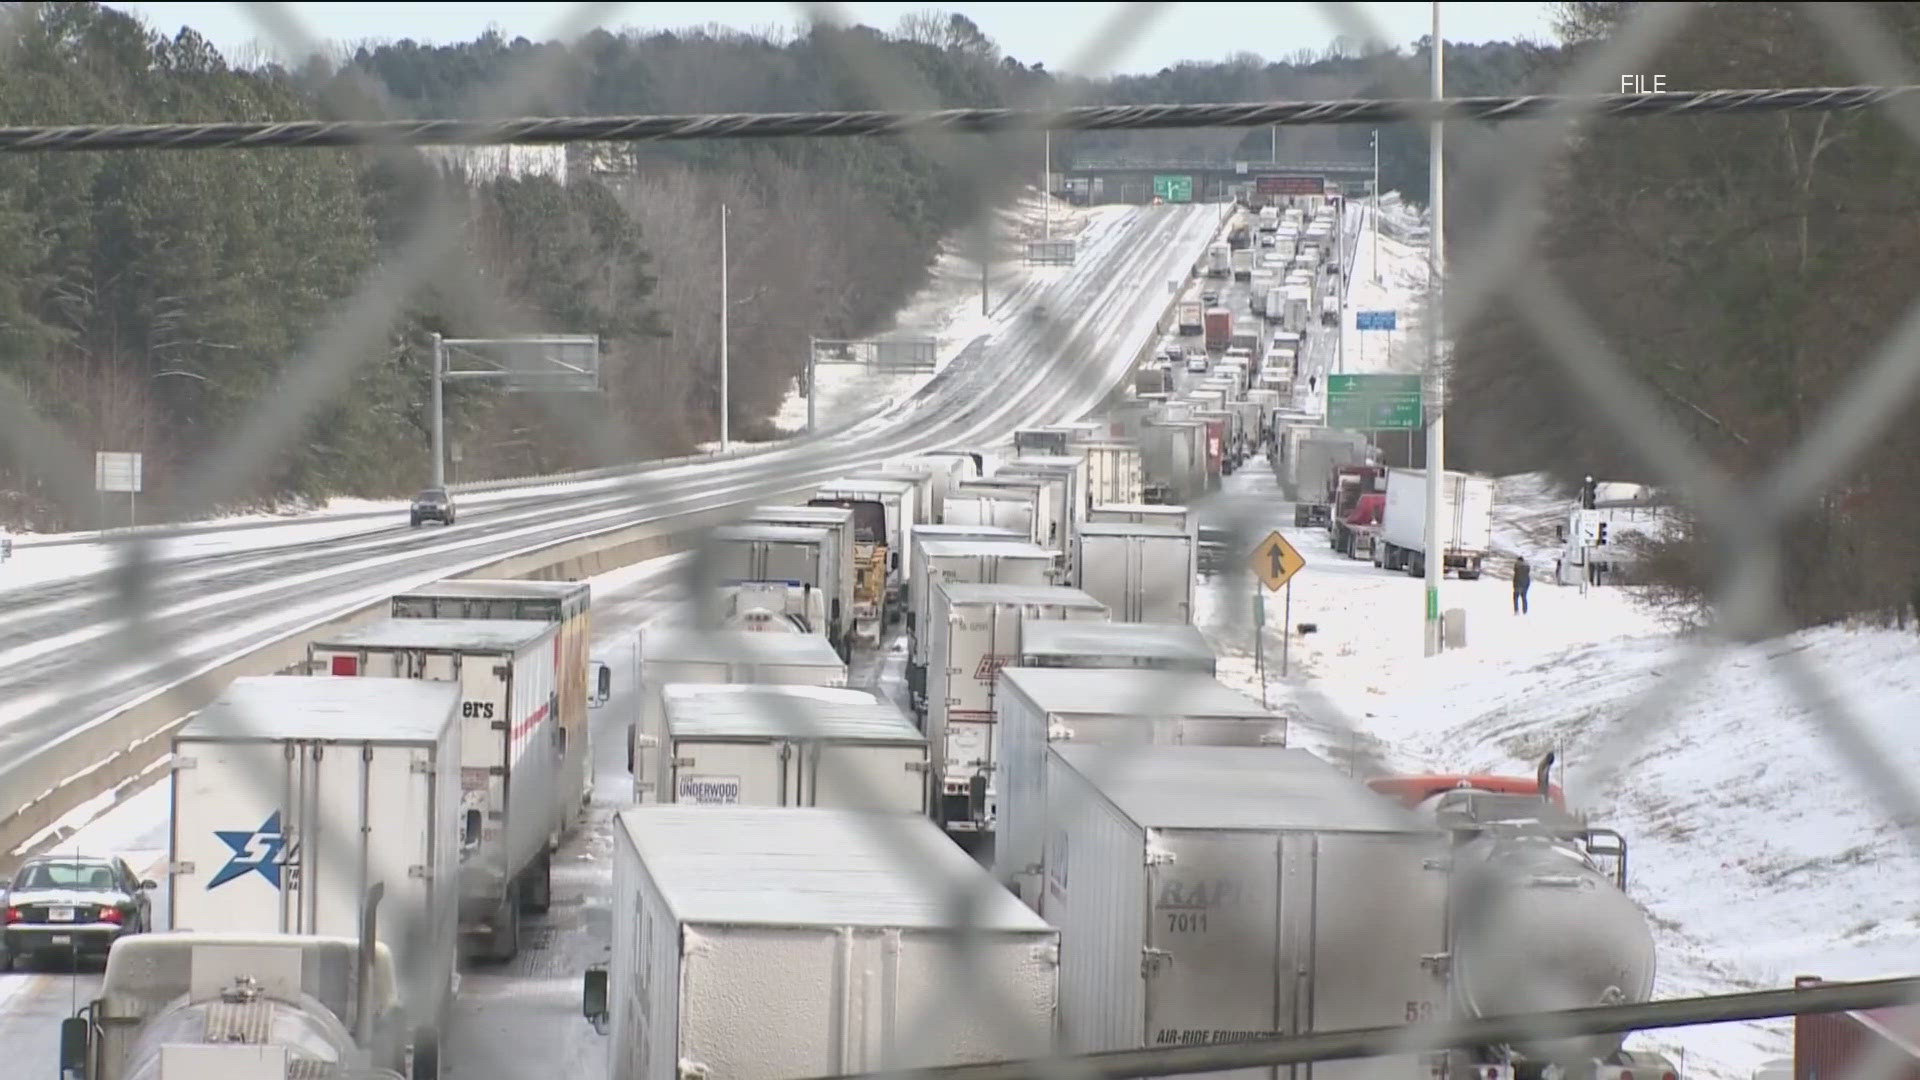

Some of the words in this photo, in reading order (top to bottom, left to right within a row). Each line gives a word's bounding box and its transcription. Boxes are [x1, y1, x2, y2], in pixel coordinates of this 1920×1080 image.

[462, 701, 494, 719] ers
[679, 783, 738, 798] UNDERWOOD
[1168, 913, 1207, 933] 7011
[1157, 1029, 1210, 1045] AIR-RIDE
